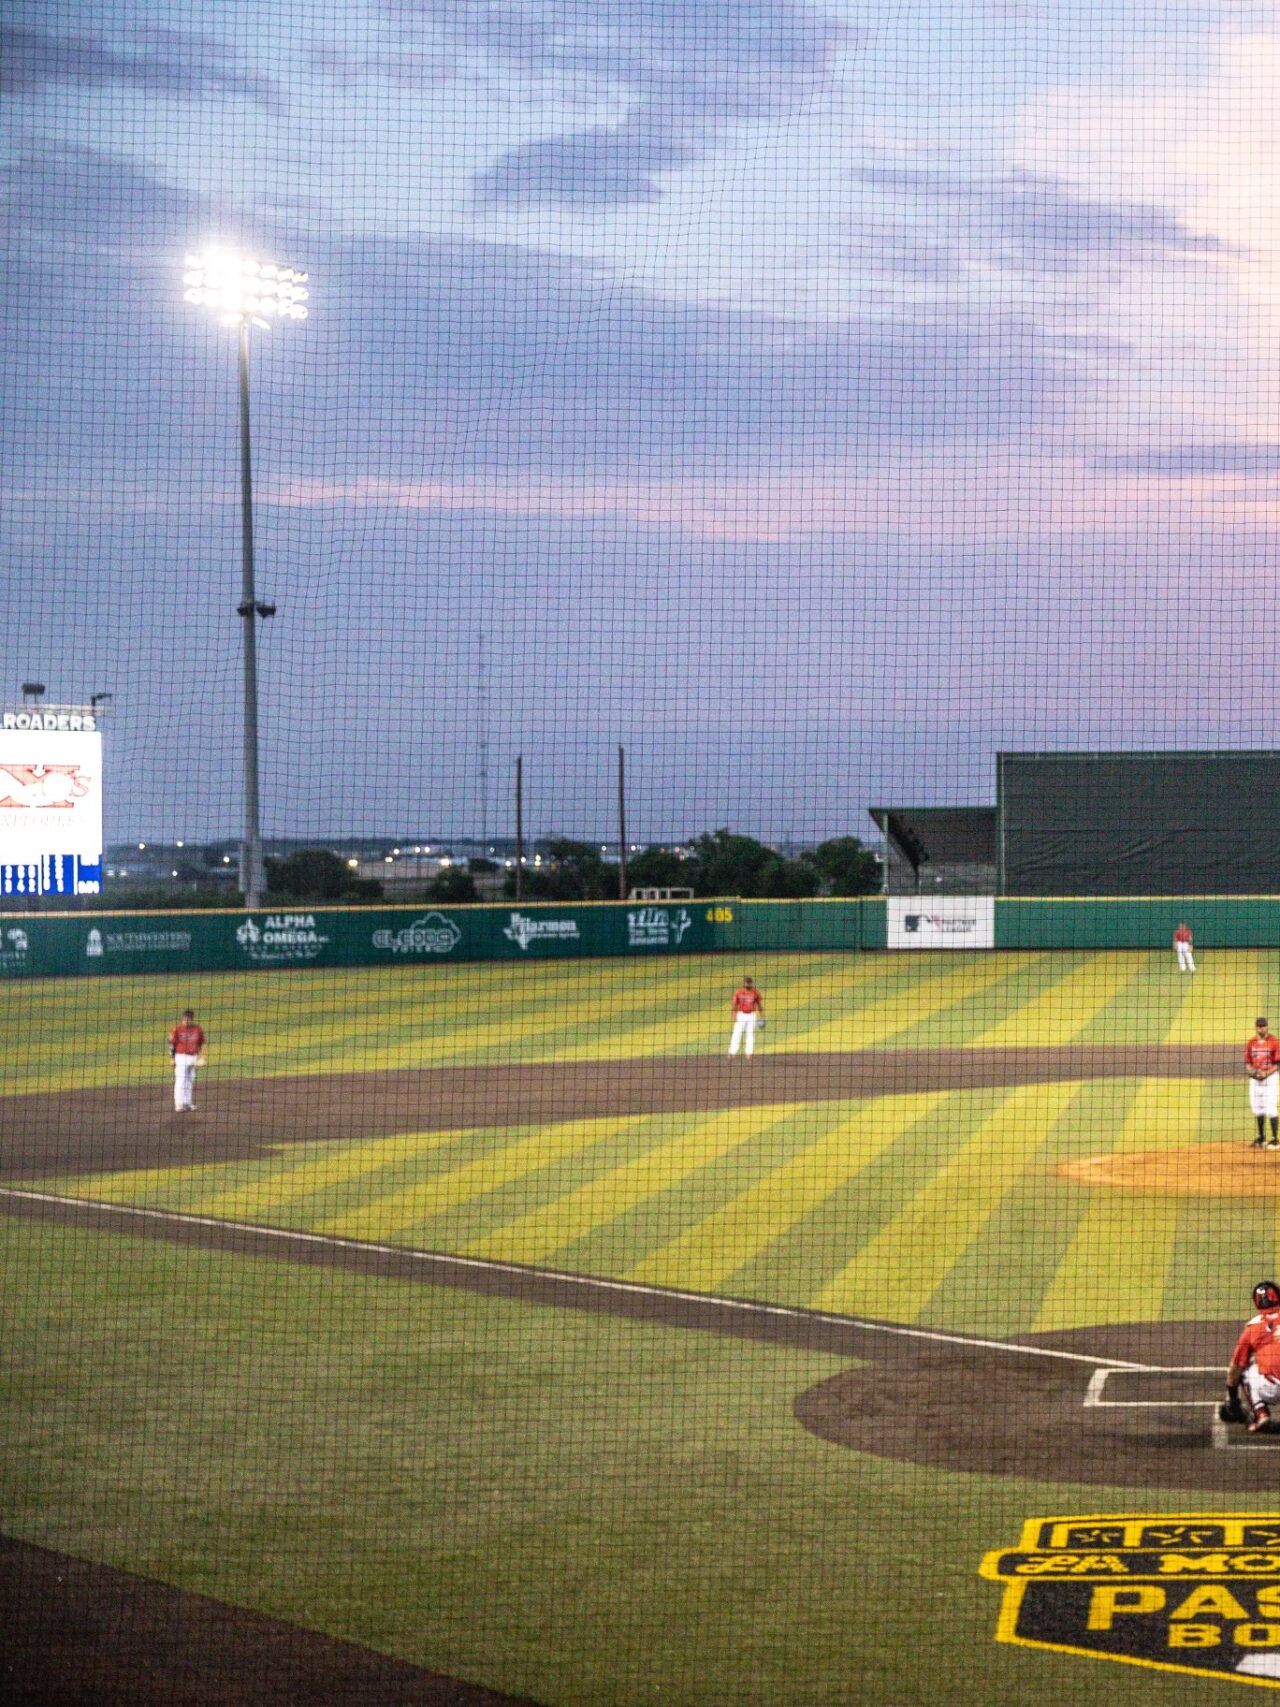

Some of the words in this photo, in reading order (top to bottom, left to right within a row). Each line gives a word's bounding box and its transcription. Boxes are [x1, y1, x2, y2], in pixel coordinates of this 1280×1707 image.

[264, 914, 316, 929] ALPHA
[263, 930, 317, 944] OMEGA
[1015, 1554, 1128, 1574] LA
